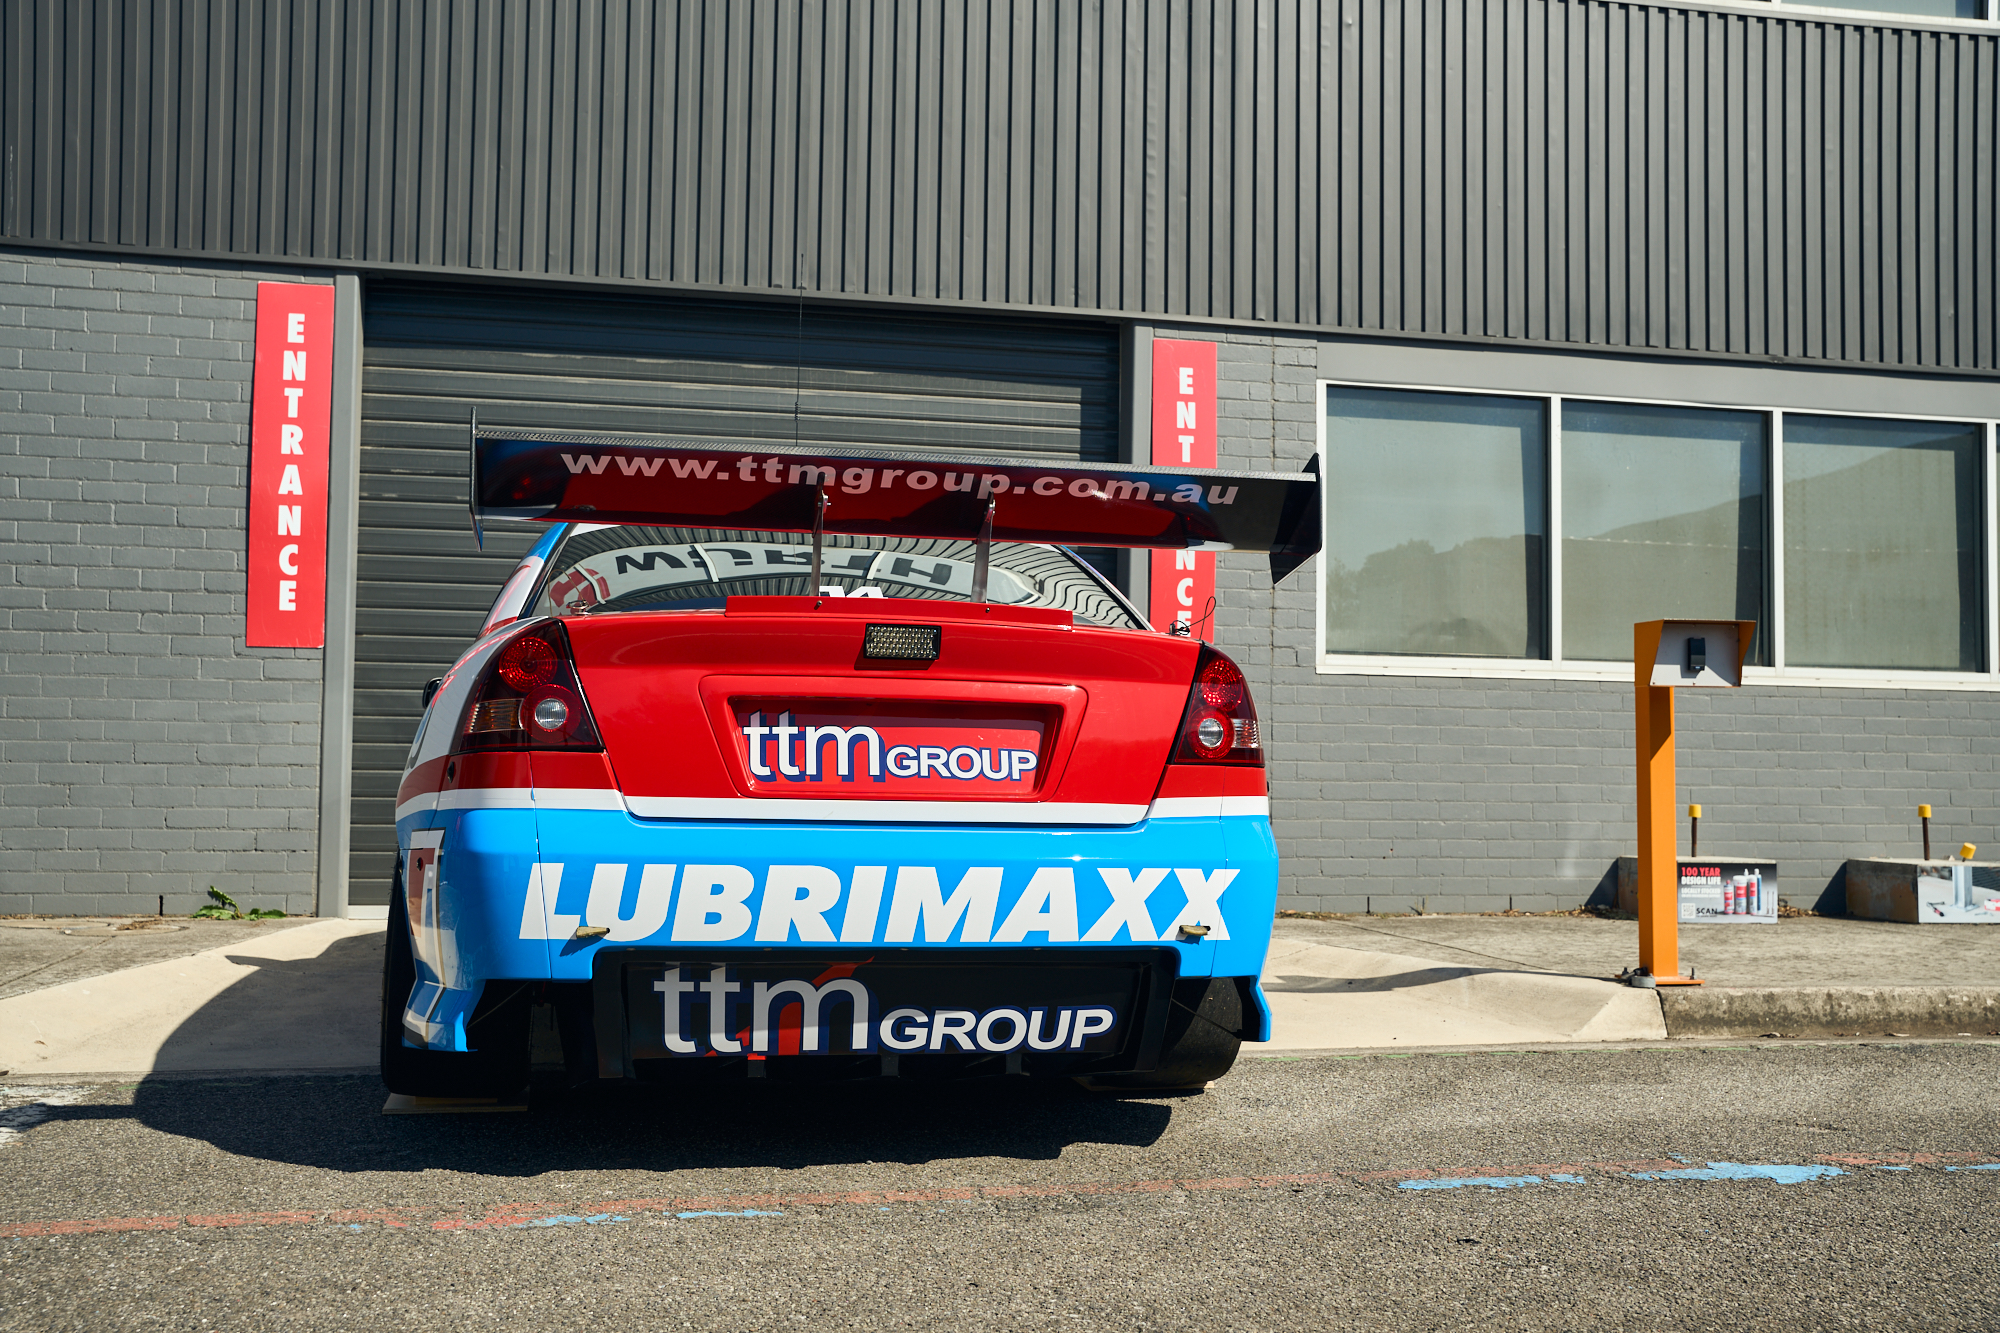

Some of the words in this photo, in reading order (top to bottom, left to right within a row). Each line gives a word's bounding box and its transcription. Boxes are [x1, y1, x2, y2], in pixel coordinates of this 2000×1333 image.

[277, 312, 307, 611] ENTRANCE
[560, 453, 1239, 505] www.ttmgroup.com.au
[1175, 366, 1196, 638] ENTNCE
[742, 709, 884, 780] ttm
[885, 745, 1037, 781] GROUP
[519, 862, 1240, 943] LUBRIMAXX
[1681, 867, 1698, 876] 100
[1700, 867, 1721, 876] YEAR
[1681, 876, 1707, 885] DESIGN
[1707, 876, 1721, 885] LIFE
[653, 962, 870, 1053] ttm
[879, 1007, 1114, 1052] GROUP
